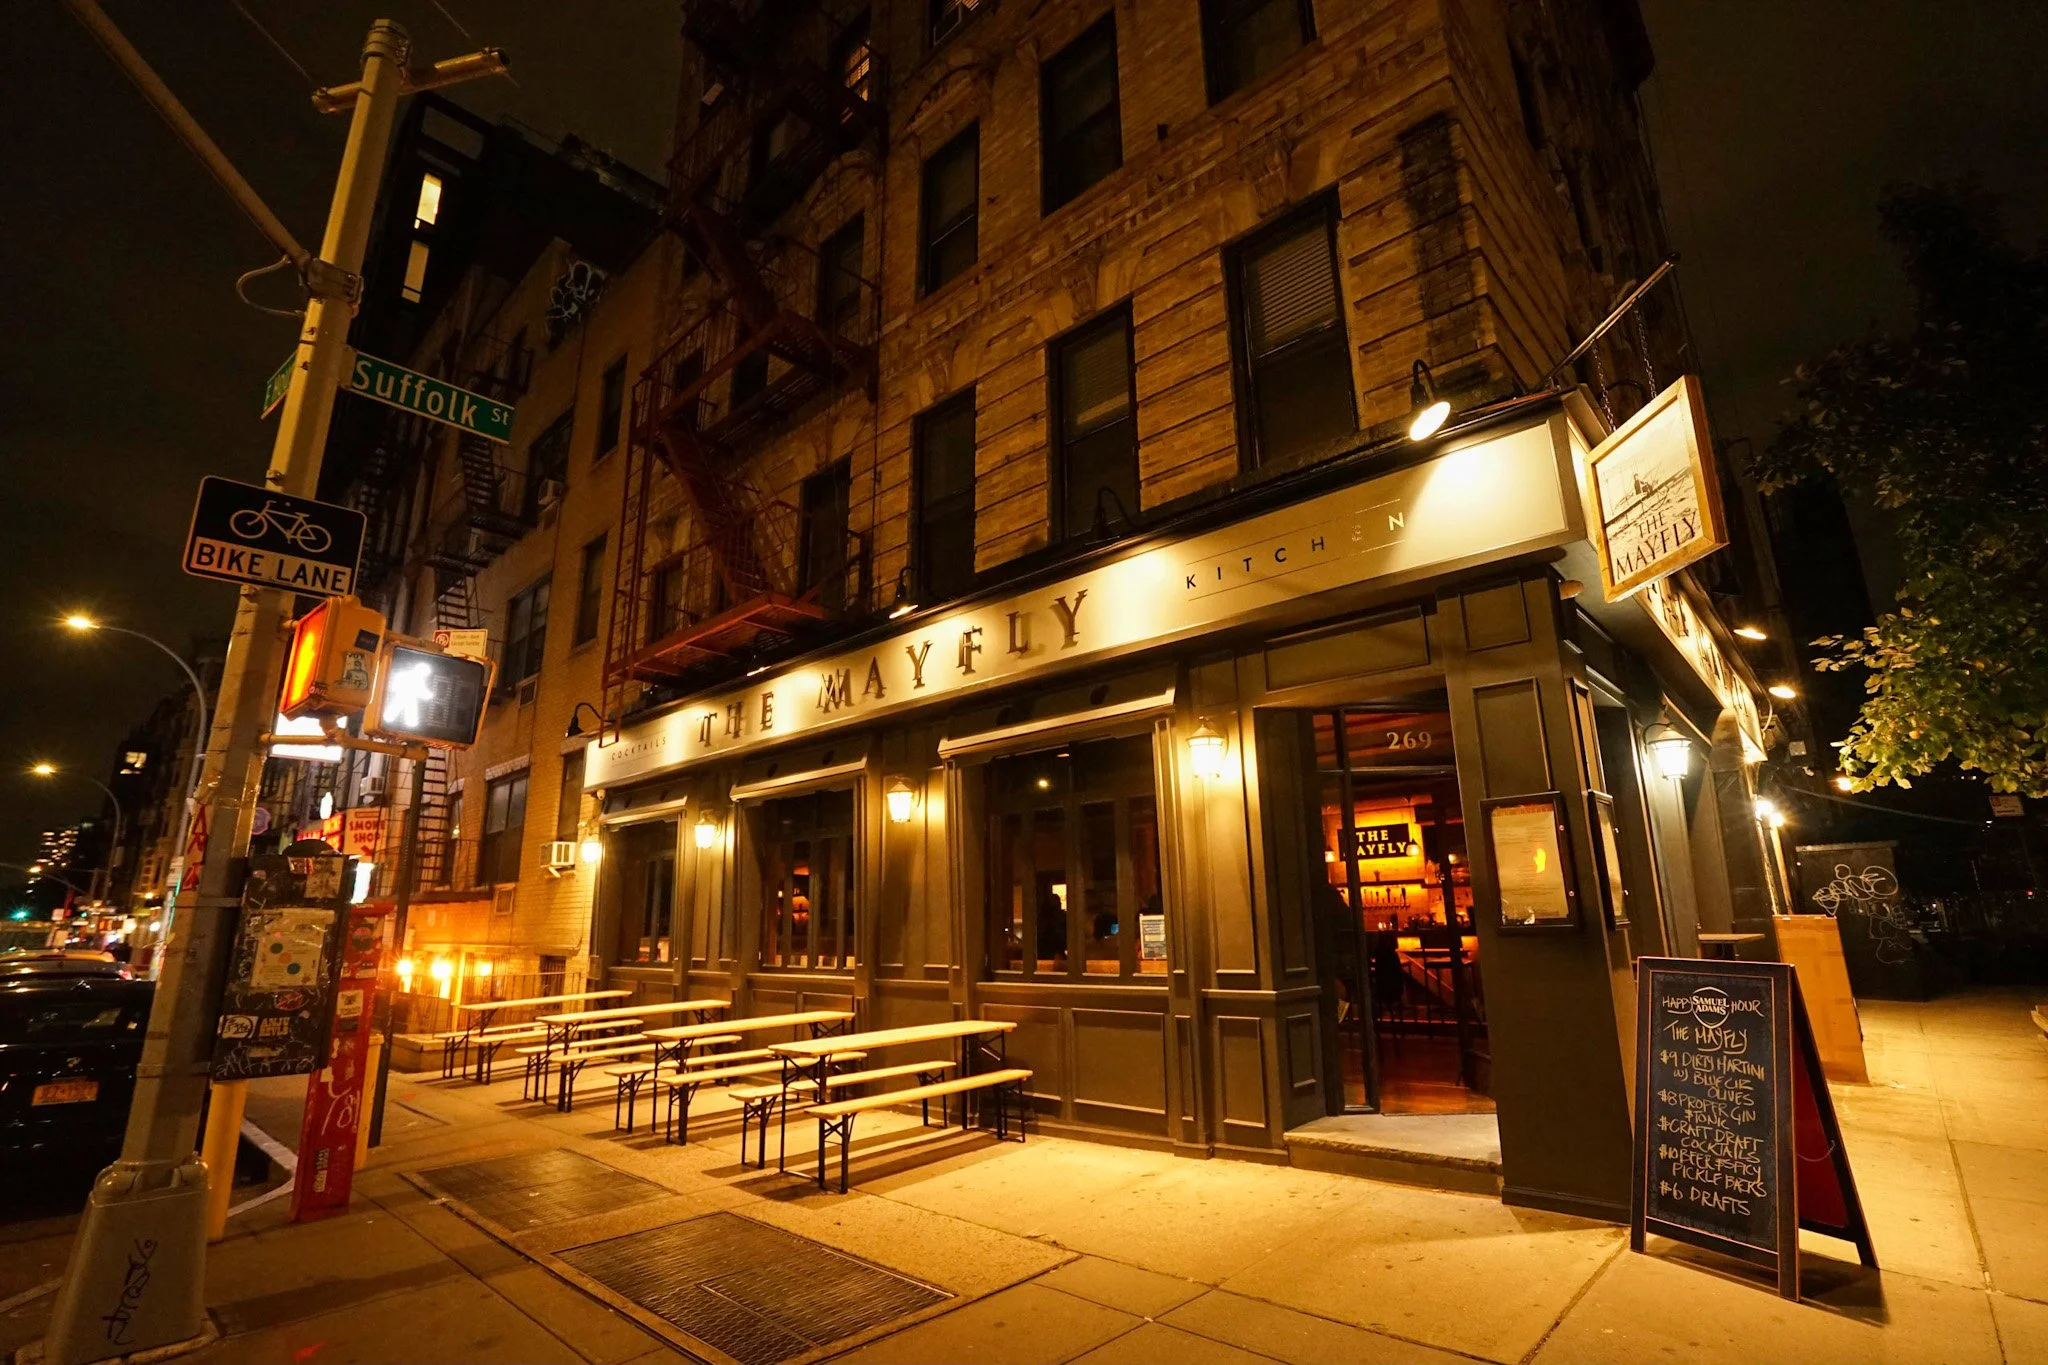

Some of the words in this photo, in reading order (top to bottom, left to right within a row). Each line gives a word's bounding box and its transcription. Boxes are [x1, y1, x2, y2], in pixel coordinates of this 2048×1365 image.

[352, 360, 475, 428] Suffolk
[491, 407, 510, 426] St
[1638, 511, 1667, 538] THE
[1615, 511, 1697, 580] MAYFLY
[196, 543, 264, 577] BIKE
[276, 558, 347, 593] LANE
[698, 691, 774, 747] THE
[816, 588, 1088, 714] MAYFLY
[611, 736, 666, 761] COCKTAILS
[1386, 731, 1432, 750] 269
[353, 832, 381, 844] SHOP
[1356, 830, 1389, 843] THE
[1356, 842, 1407, 856] AYFLY
[1662, 995, 1693, 1014] HAPPY
[1693, 995, 1729, 1007] SAMUEL
[1695, 1005, 1726, 1015] ADAMS
[1731, 1000, 1764, 1017] HOUR
[1663, 1020, 1689, 1040] THE
[1695, 1027, 1747, 1054] MAYFLY
[1660, 1049, 1678, 1067] $9
[1708, 1086, 1754, 1106] OLIVES
[1679, 1093, 1729, 1117] PROPER
[1730, 1106, 1756, 1125] GIN
[1681, 1136, 1761, 1163] COCKTAILS
[1714, 1129, 1764, 1151] DRAFT
[1672, 1162, 1722, 1185] PICKLE
[1690, 1186, 1751, 1216] DRAFTS
